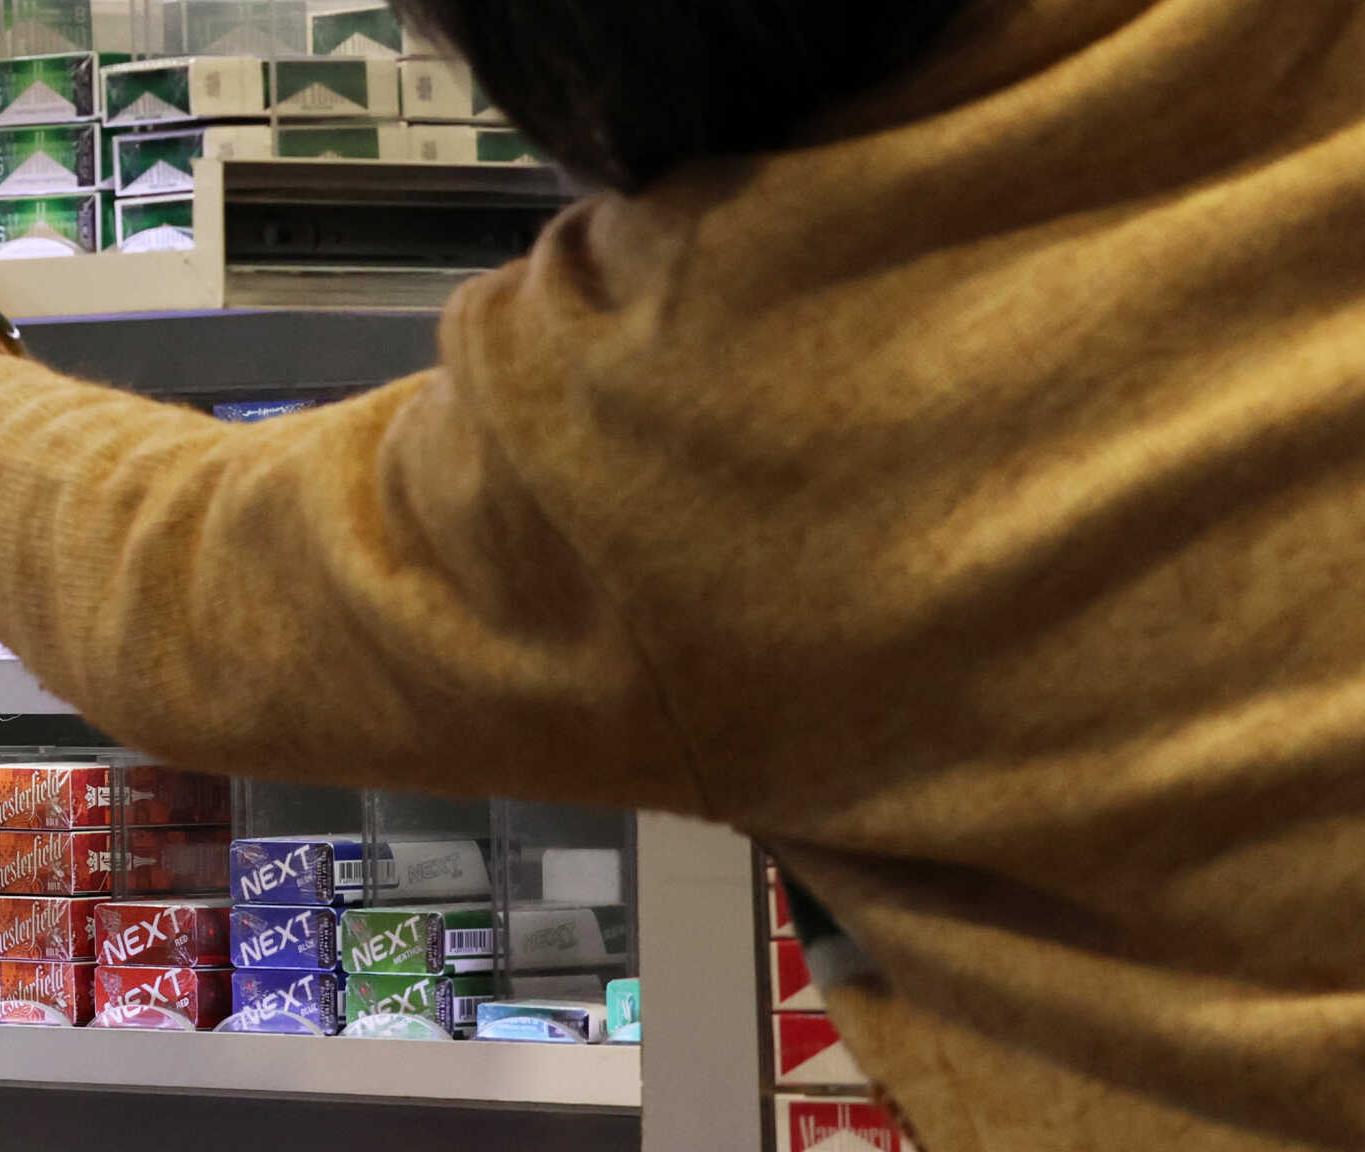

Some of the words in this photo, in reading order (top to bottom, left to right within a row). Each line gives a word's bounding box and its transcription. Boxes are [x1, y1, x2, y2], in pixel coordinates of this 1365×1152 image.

[240, 844, 311, 901] NEXT
[407, 852, 463, 884] NEXT
[103, 906, 182, 965] NEXT
[174, 935, 189, 946] RED
[240, 910, 311, 966] NEXT
[352, 915, 420, 971] NEXT
[101, 968, 182, 1026] NEXT
[176, 997, 190, 1008] RED
[241, 974, 314, 1029] NEXT
[353, 978, 430, 1035] NEXT
